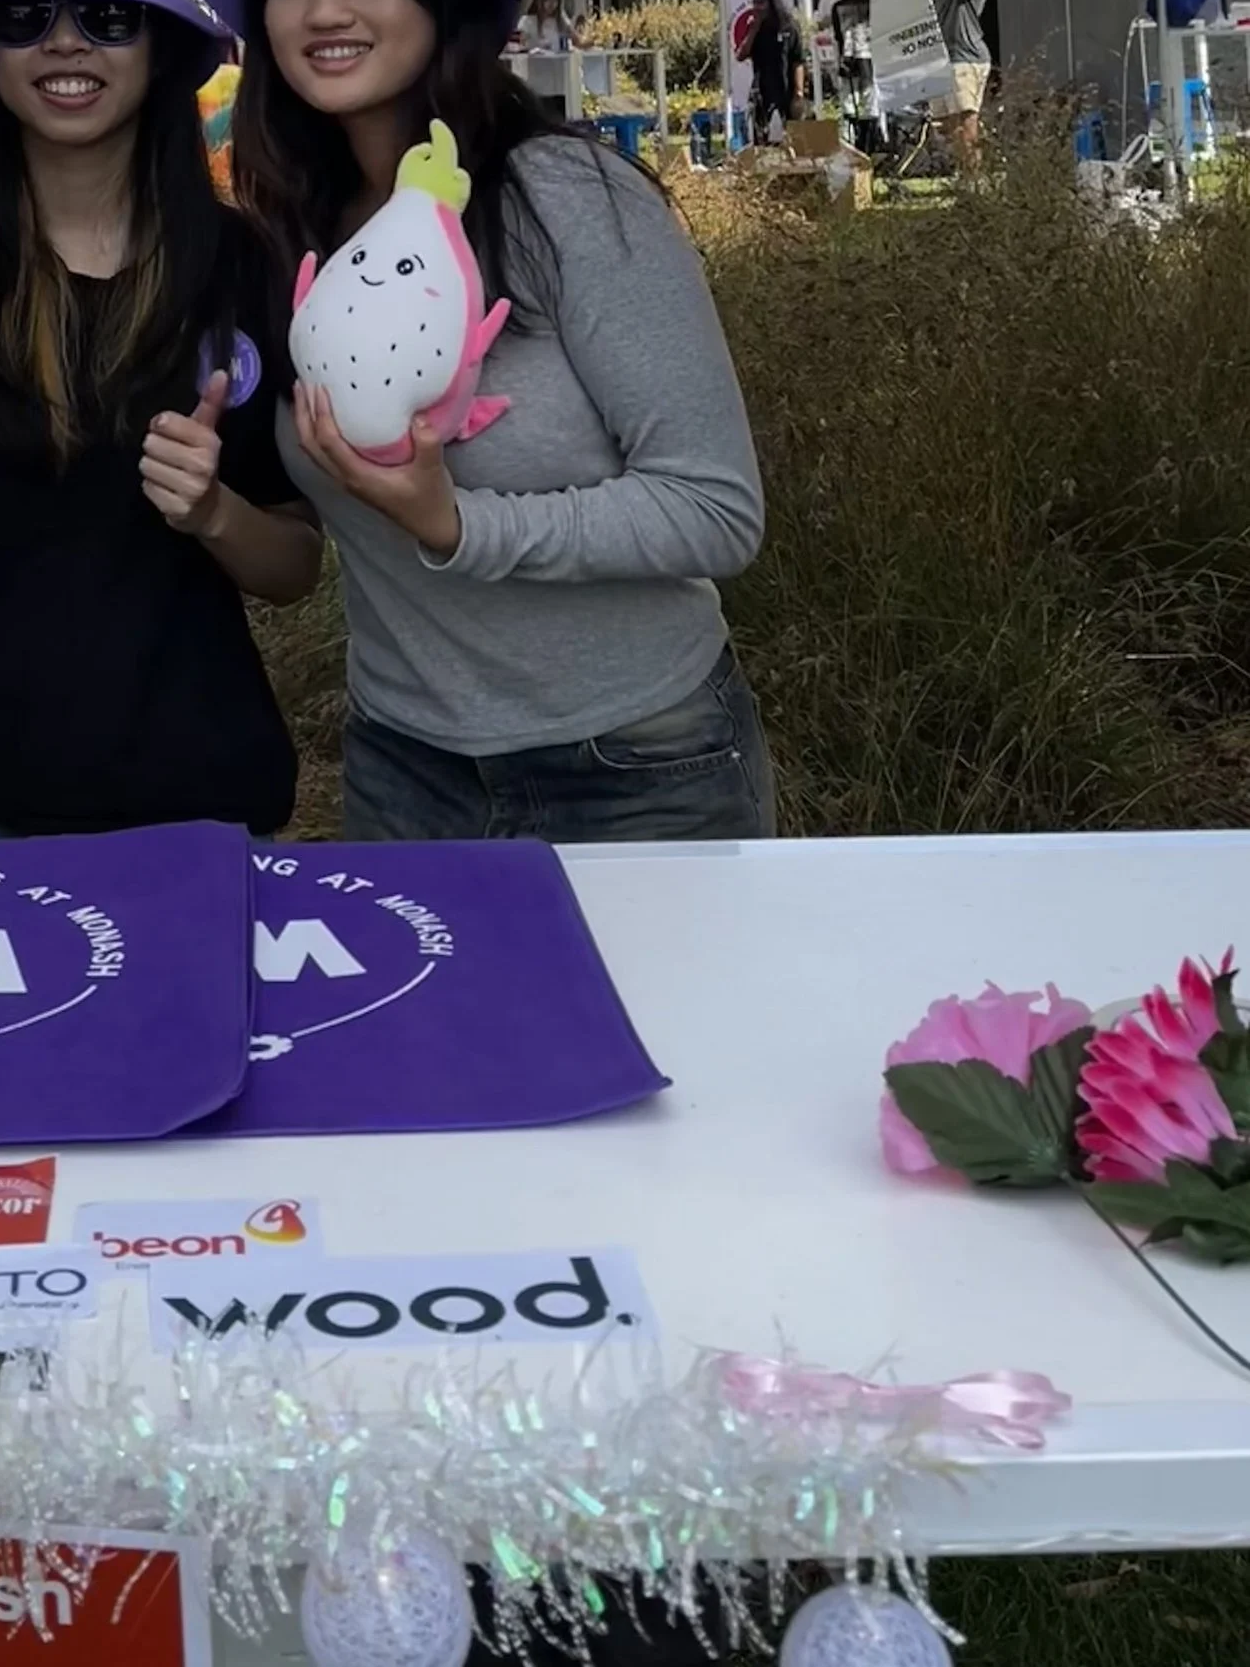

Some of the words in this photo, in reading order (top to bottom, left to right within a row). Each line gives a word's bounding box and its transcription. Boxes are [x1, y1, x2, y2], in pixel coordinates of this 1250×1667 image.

[17, 886, 73, 907] AT
[66, 905, 125, 978] MONASH
[316, 872, 375, 894] AT
[375, 893, 455, 958] MONASH
[93, 1230, 246, 1259] beon
[161, 1255, 643, 1340] wood.
